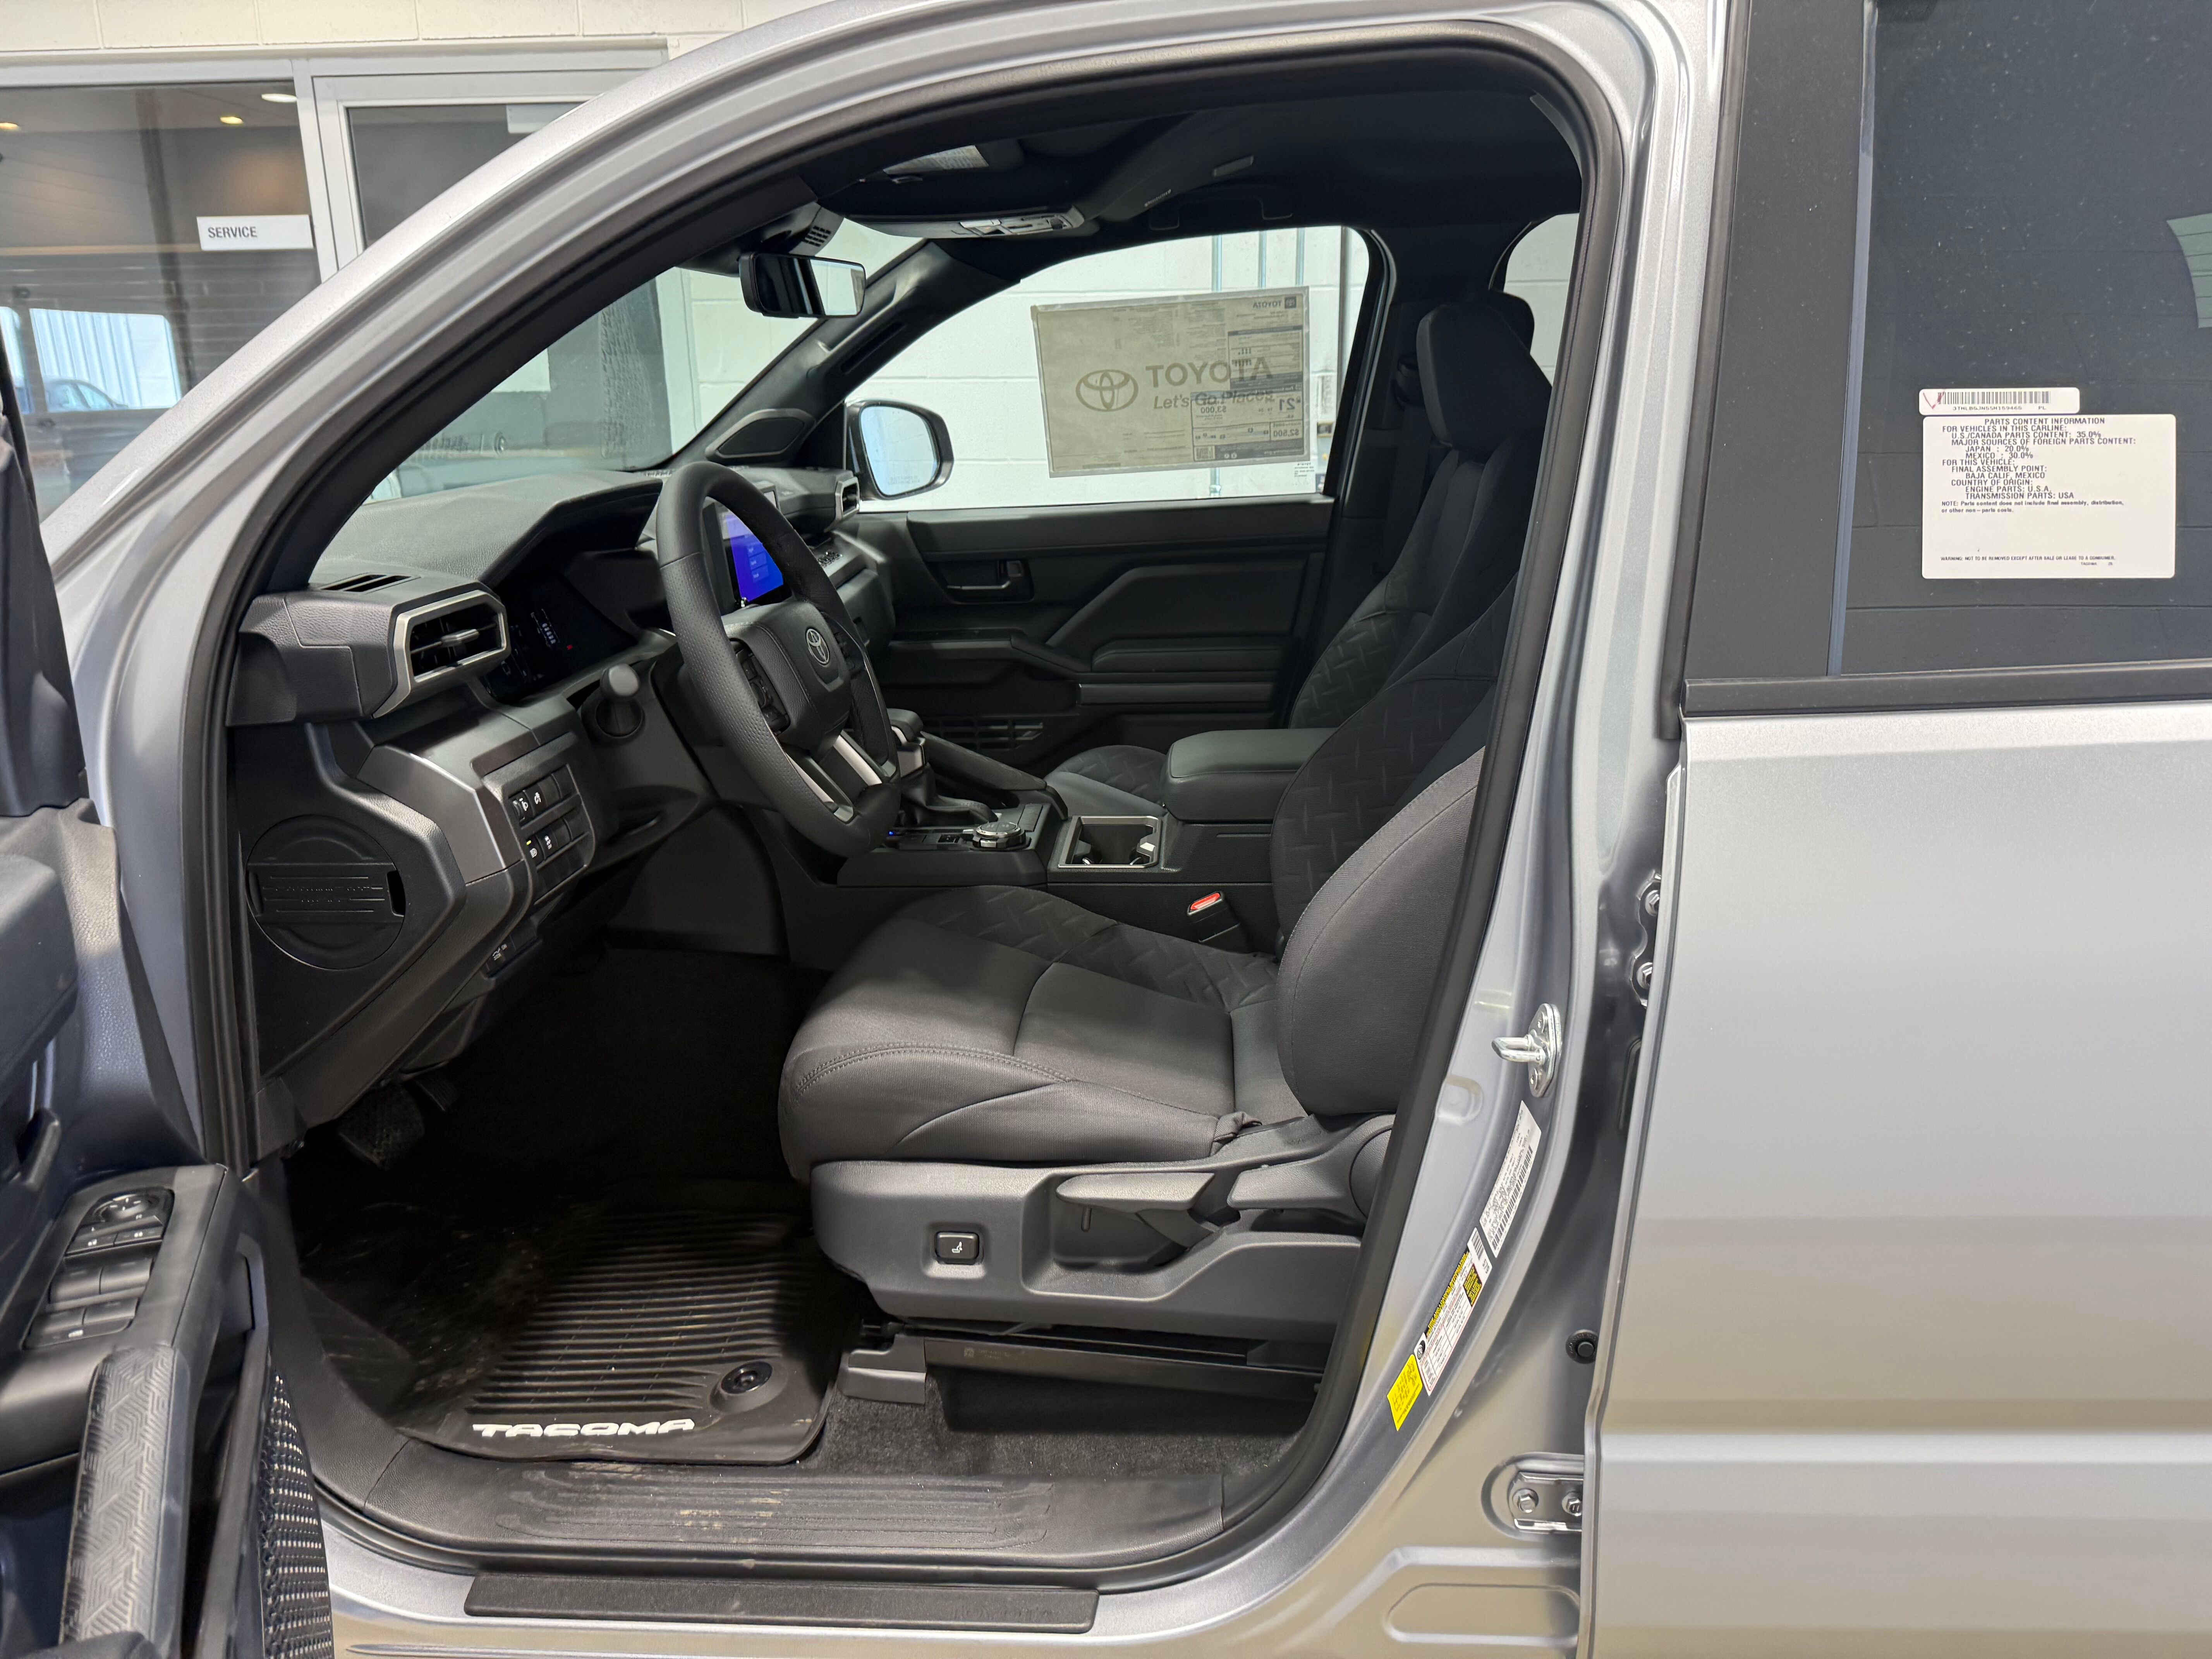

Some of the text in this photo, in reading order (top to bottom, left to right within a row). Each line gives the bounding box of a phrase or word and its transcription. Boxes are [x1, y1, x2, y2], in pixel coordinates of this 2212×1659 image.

[208, 226, 258, 238] SERVICE
[1145, 357, 1273, 388] TOYOTA
[1153, 393, 1190, 409] Let's
[472, 1418, 695, 1437] TACOMA
